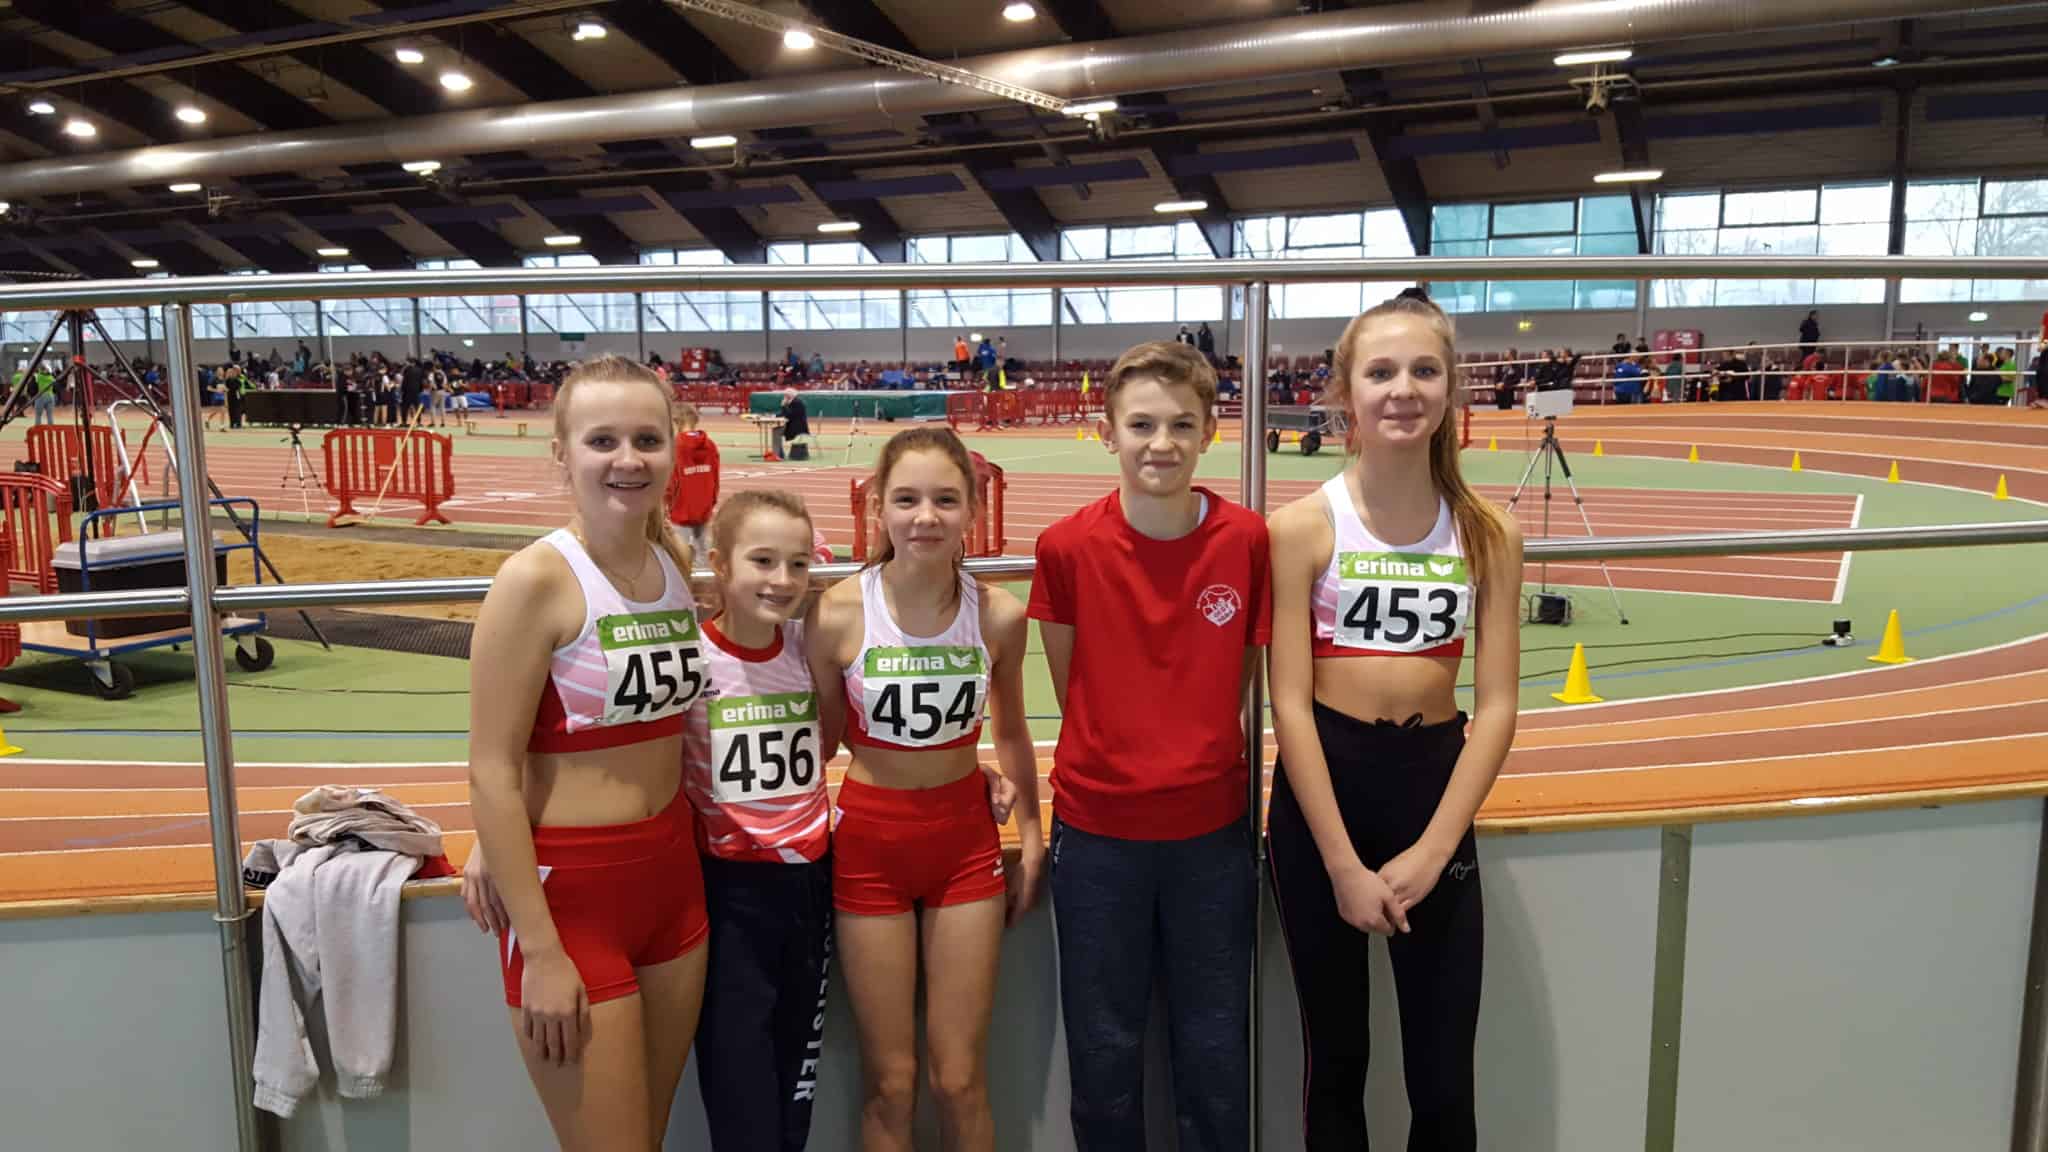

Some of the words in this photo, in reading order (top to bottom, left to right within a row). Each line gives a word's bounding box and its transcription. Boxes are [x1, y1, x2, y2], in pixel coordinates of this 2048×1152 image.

[1354, 558, 1424, 577] erima
[612, 622, 671, 642] erima
[1343, 586, 1458, 643] 453
[613, 647, 702, 715] 455
[876, 654, 945, 672] erima
[721, 701, 787, 722] erima
[871, 680, 977, 739] 454
[719, 727, 814, 792] 456
